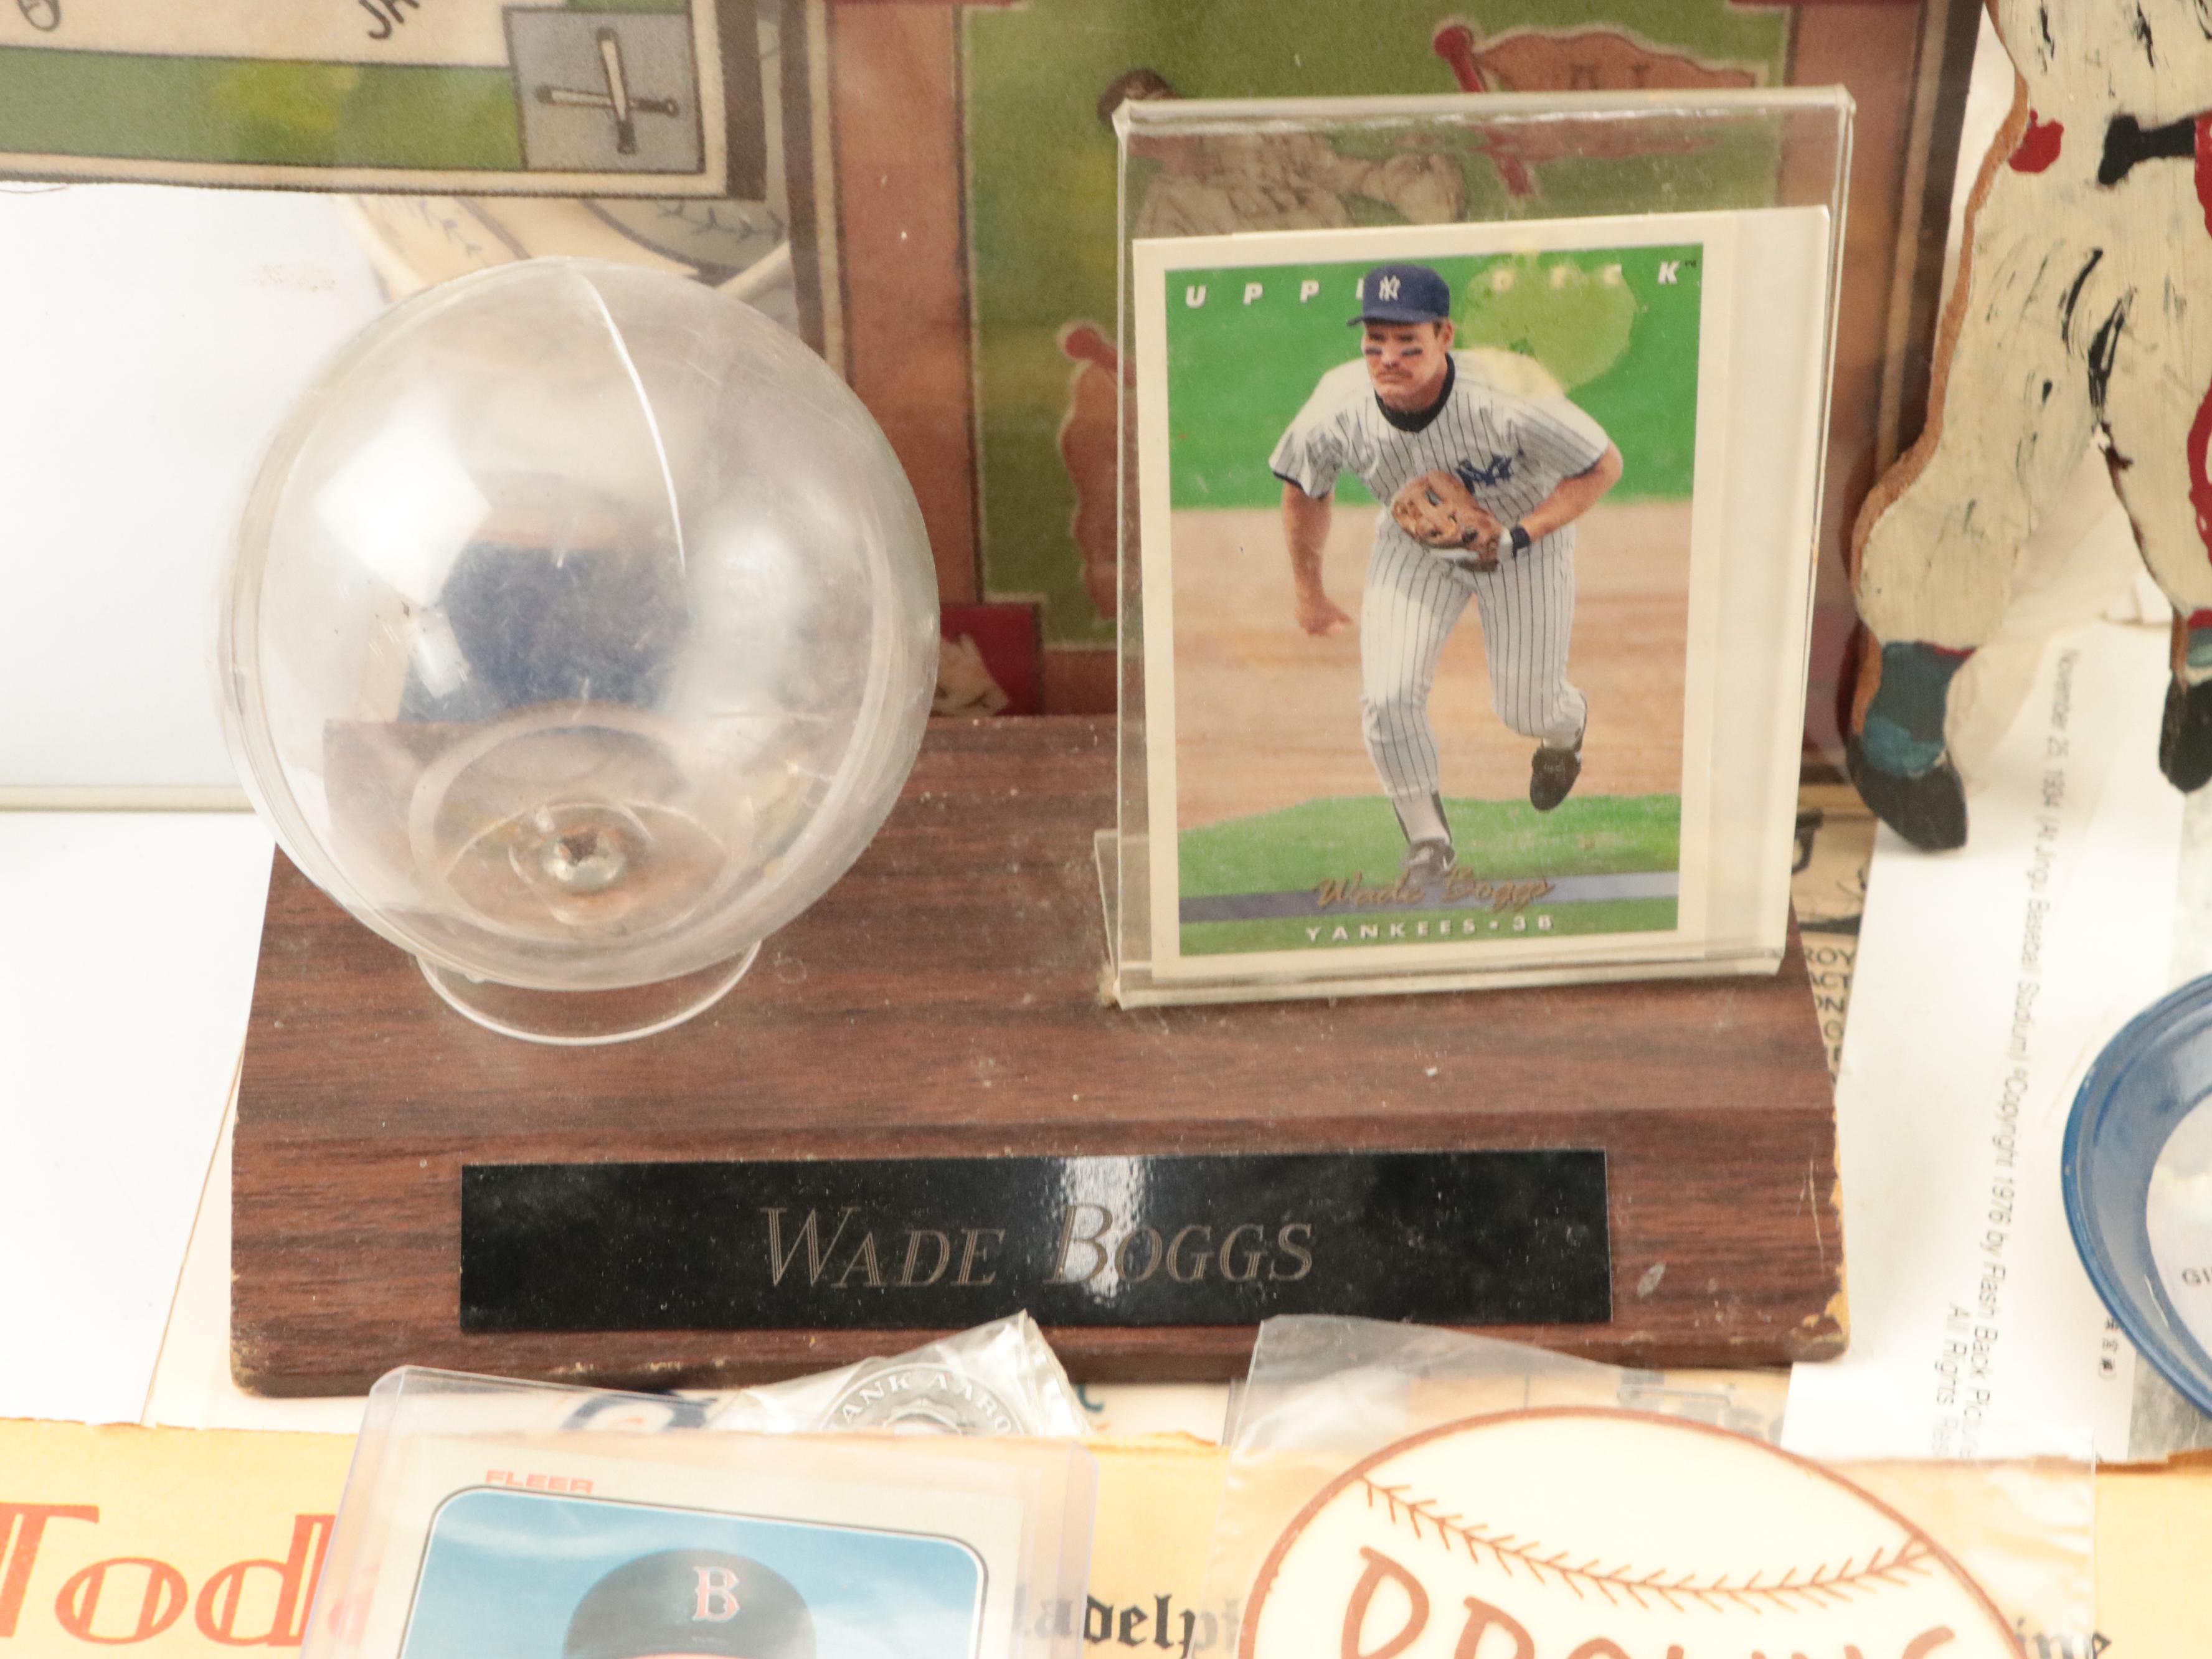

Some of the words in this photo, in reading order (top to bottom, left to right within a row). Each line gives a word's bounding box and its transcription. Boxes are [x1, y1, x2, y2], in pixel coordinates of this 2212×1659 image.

[1185, 277, 1365, 309] UPP
[1305, 919, 1476, 942] YANKEES
[1988, 1175, 2016, 1226] 1976
[760, 1206, 1006, 1288] WADE
[1042, 1203, 1314, 1285] BOGGS
[1980, 1227, 2010, 1257] by
[1976, 1260, 2006, 1320] Flash
[2181, 1266, 2212, 1288] GI
[1945, 1301, 1972, 1333] All
[1933, 1336, 1969, 1407] Rights
[1969, 1325, 1998, 1381] Back
[838, 1372, 912, 1425] ANK
[484, 1468, 594, 1495] FLEER
[692, 1565, 740, 1623] B
